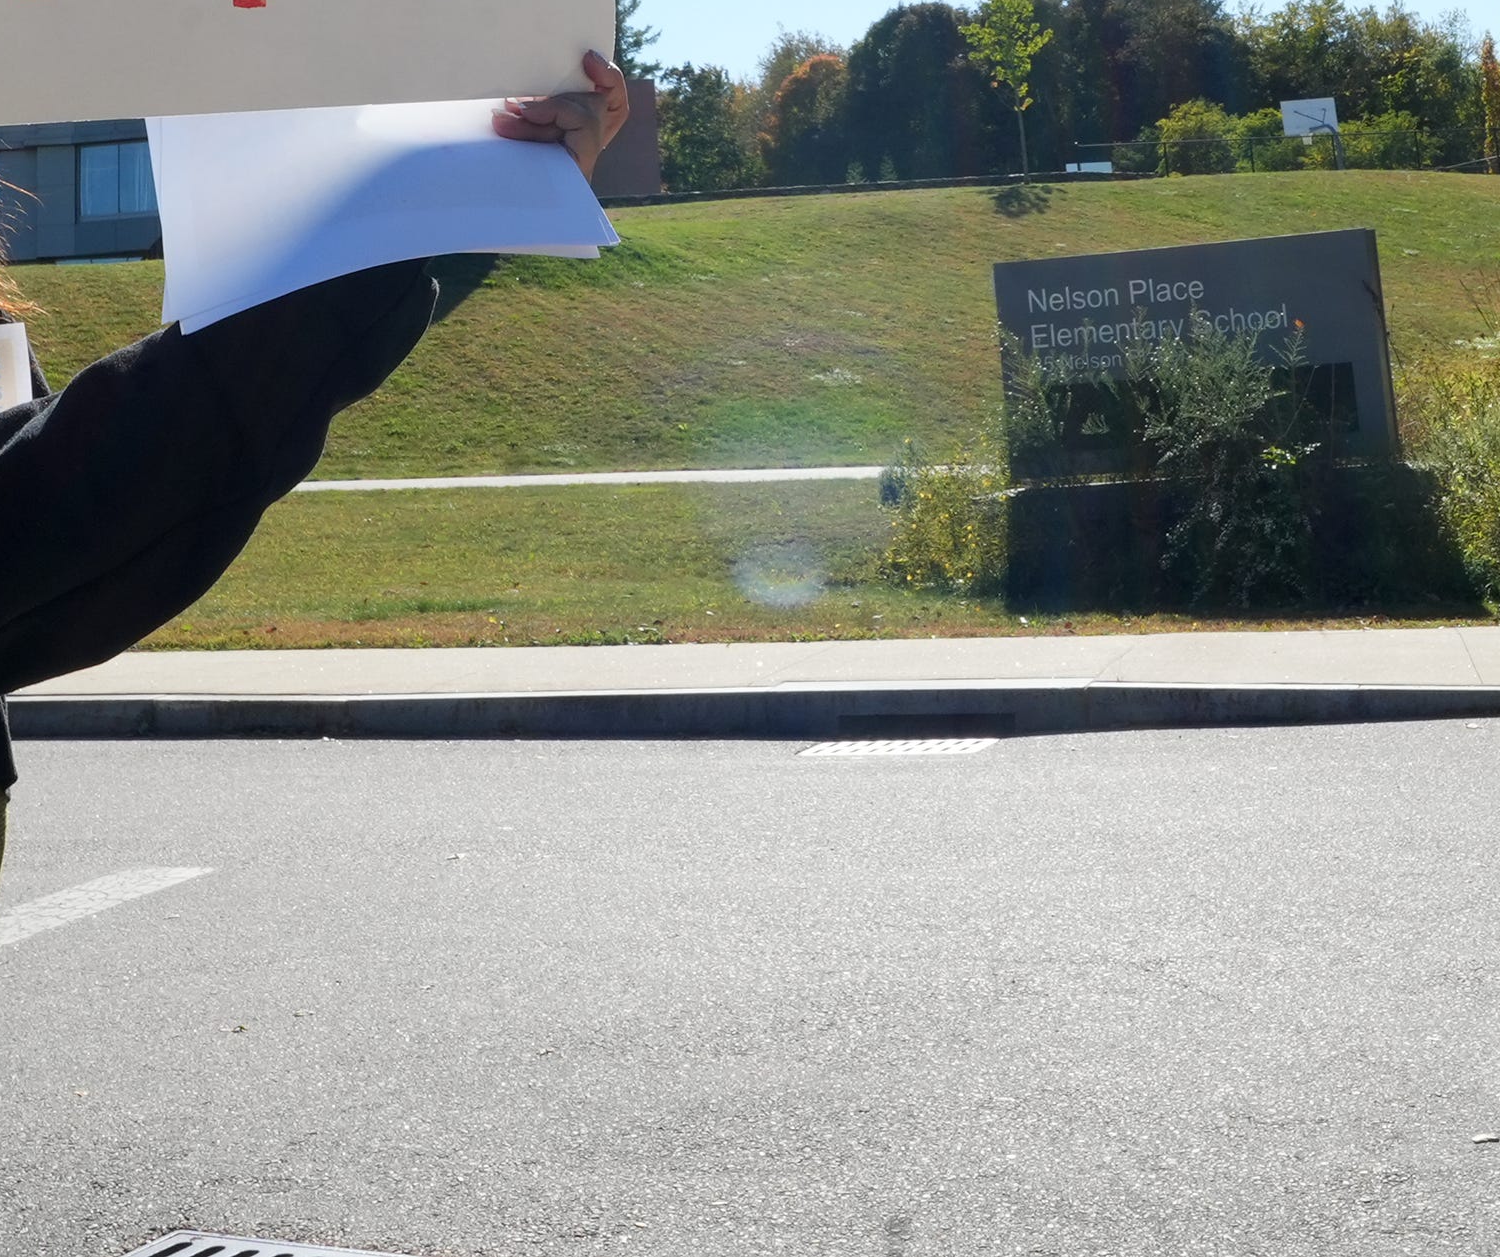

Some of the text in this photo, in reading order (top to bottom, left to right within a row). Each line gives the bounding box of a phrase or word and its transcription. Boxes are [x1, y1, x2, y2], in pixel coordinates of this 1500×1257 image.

[1027, 277, 1205, 313] Nelson Place
[1030, 303, 1288, 349] Elementary School
